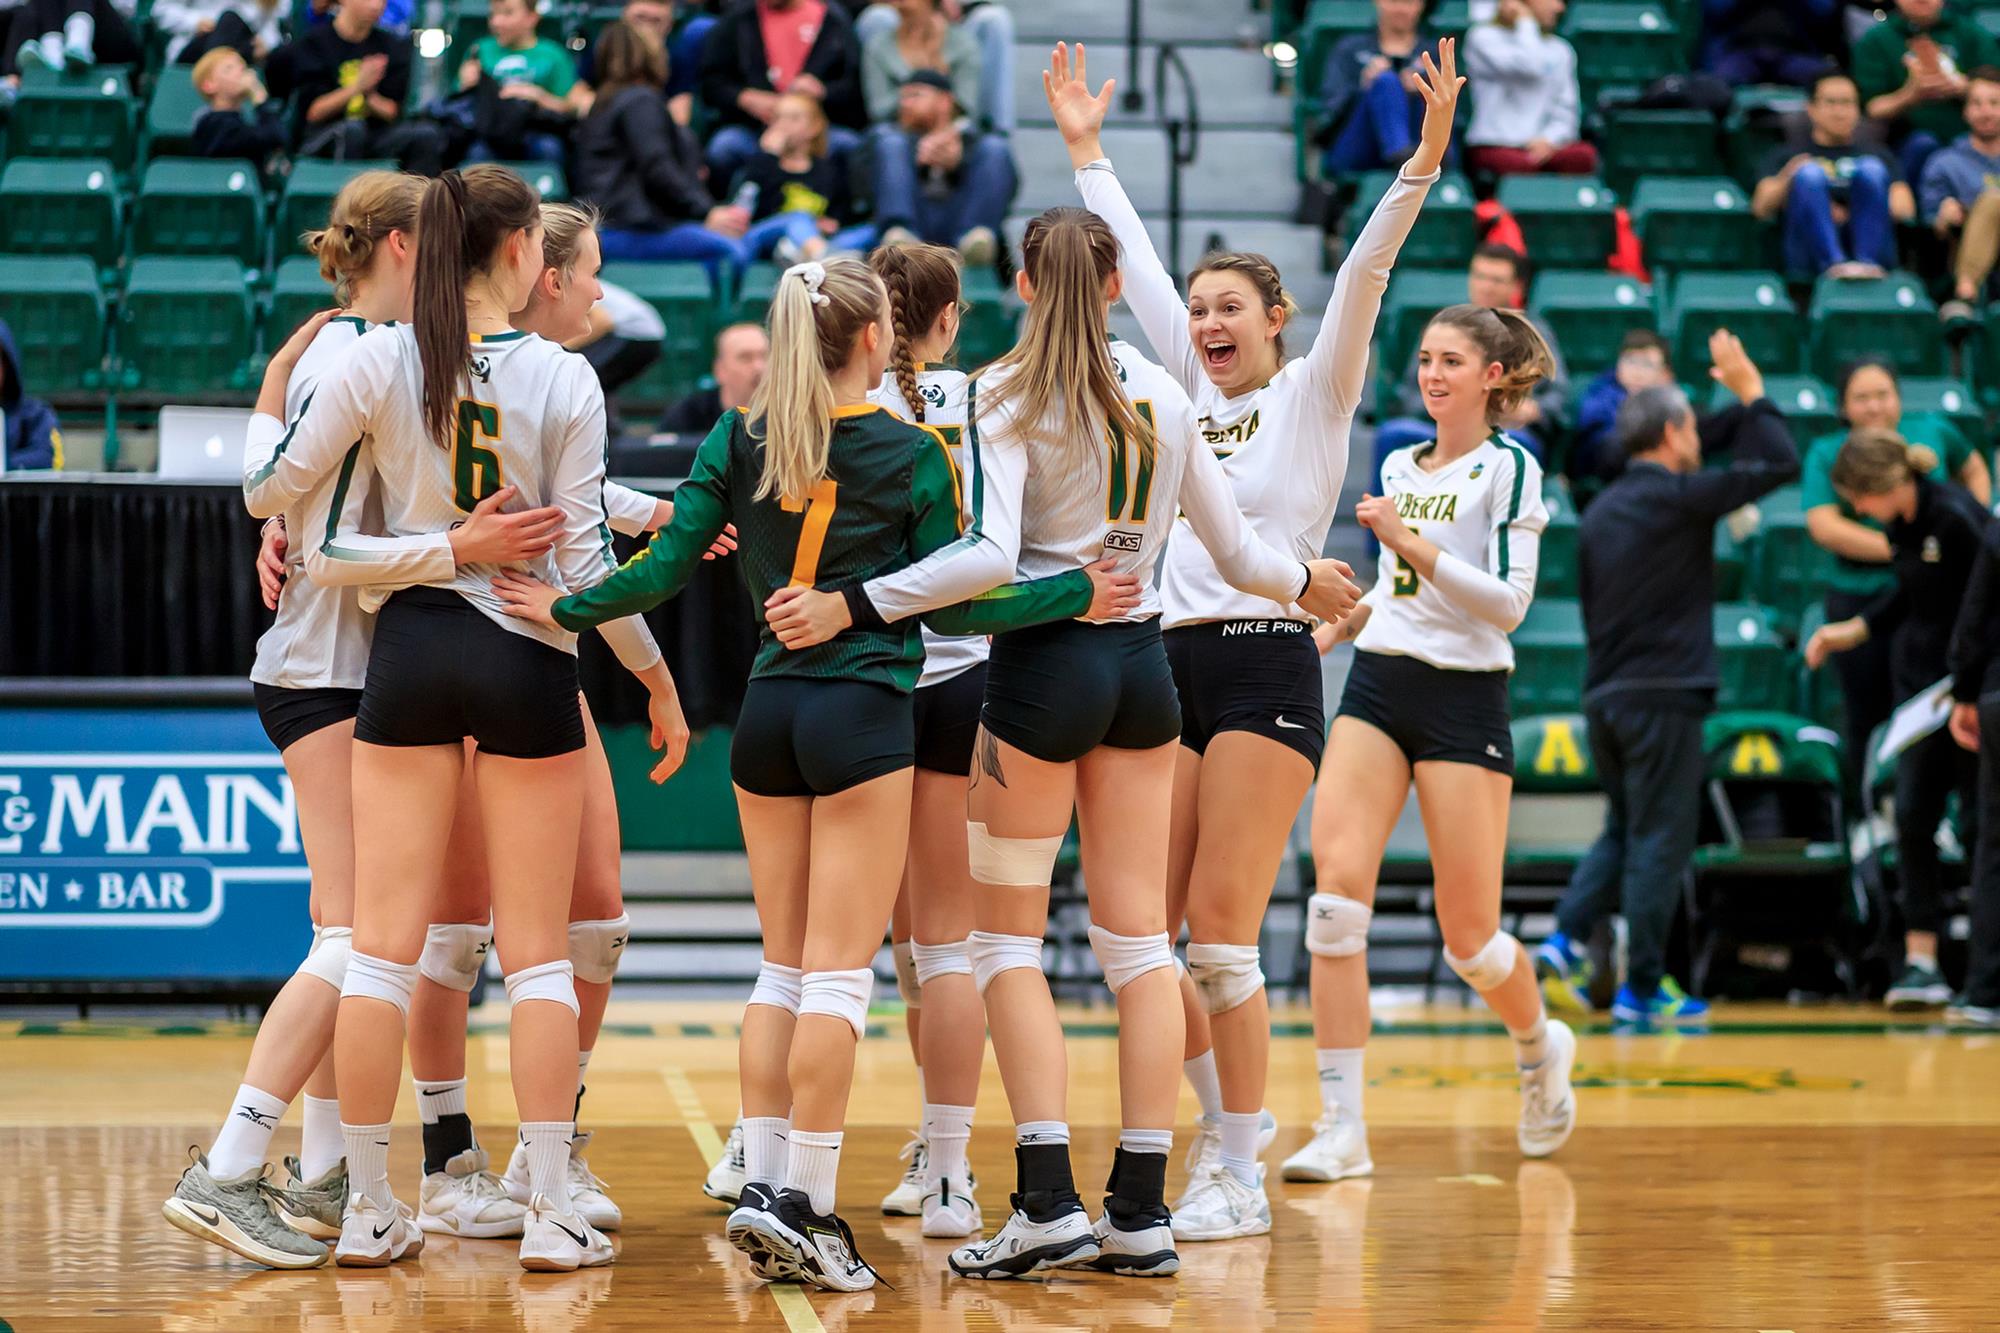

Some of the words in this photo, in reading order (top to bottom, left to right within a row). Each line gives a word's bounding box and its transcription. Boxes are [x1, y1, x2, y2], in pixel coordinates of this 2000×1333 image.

[451, 396, 504, 518] 6
[1104, 399, 1158, 525] 11
[780, 479, 838, 590] 7
[1222, 621, 1269, 637] NIKE
[1272, 621, 1304, 633] PRO
[1534, 720, 1585, 775] A
[1731, 733, 1782, 775] A
[40, 775, 300, 854] MAIN
[98, 872, 190, 909] BAR
